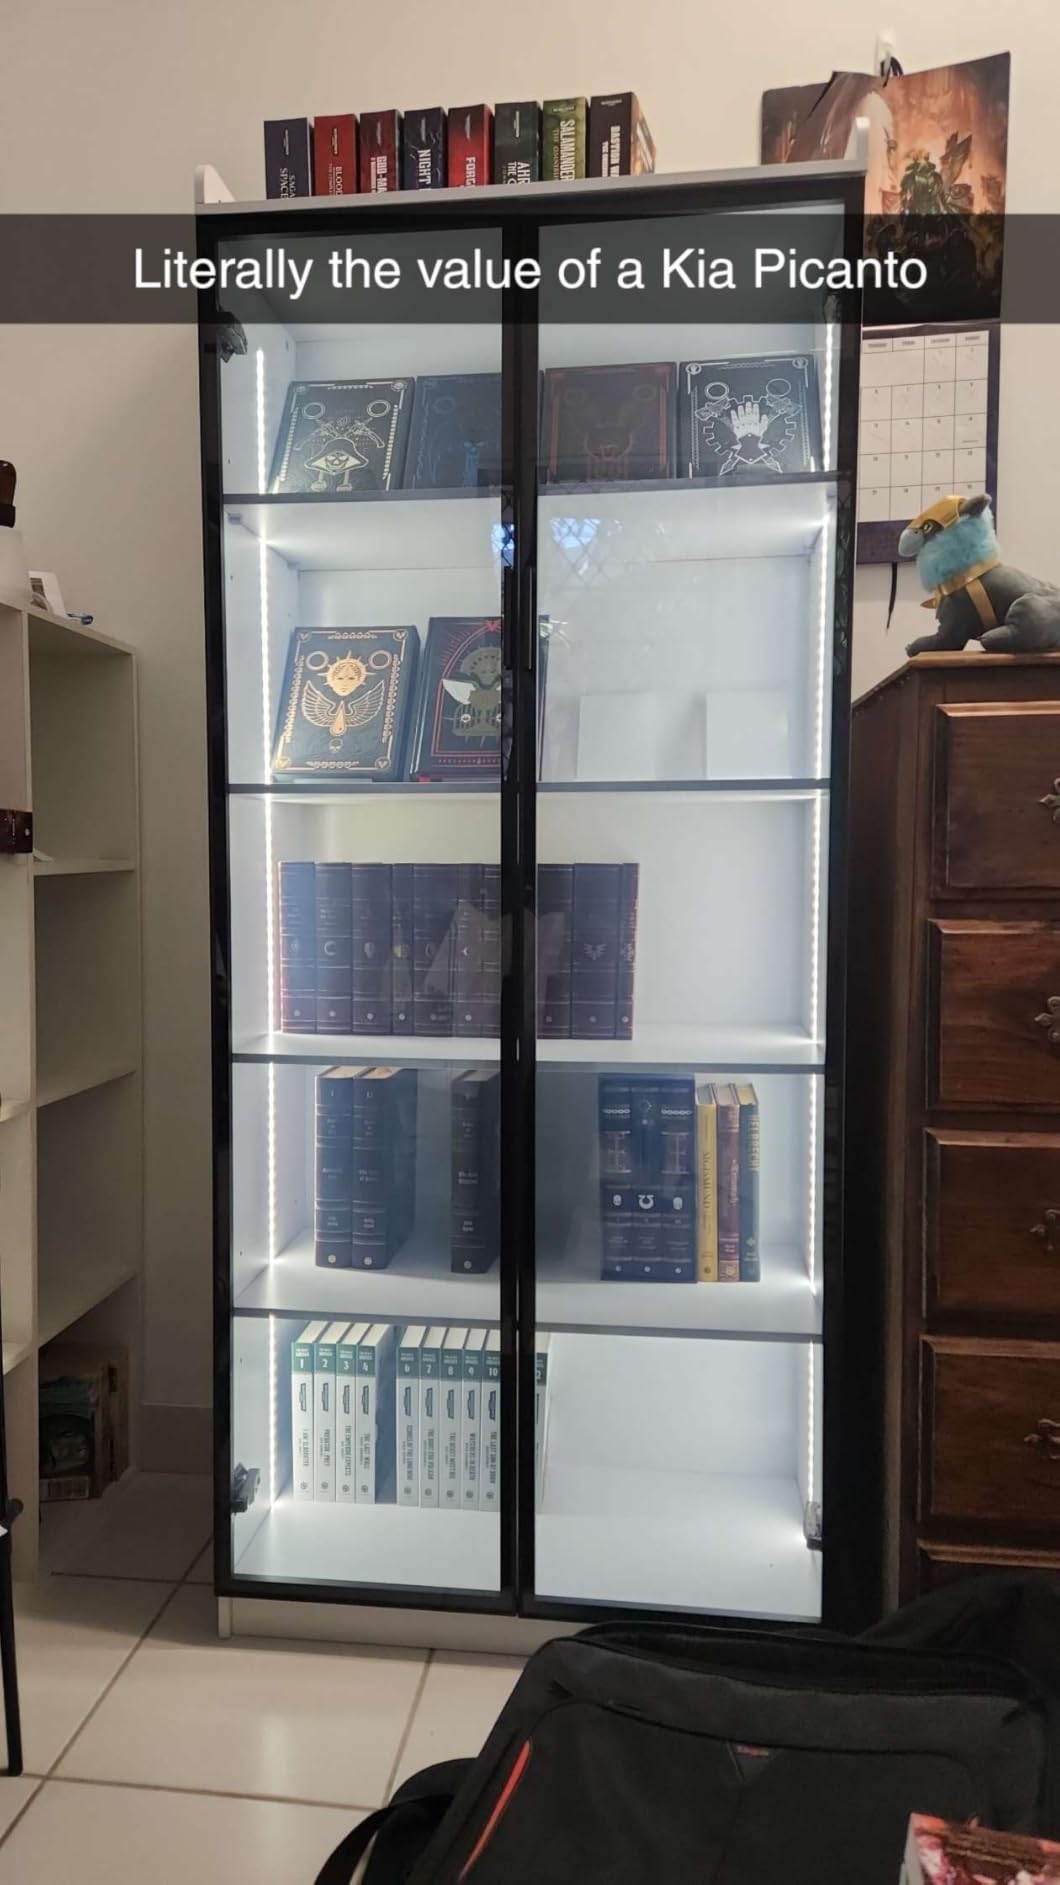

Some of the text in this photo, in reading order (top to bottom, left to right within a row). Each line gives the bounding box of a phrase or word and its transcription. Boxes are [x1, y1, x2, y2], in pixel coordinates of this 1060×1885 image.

[418, 149, 431, 184] NIGHT
[508, 161, 516, 176] THE
[466, 157, 476, 187] FORG
[300, 1359, 304, 1368] 1
[322, 1359, 328, 1368] 2
[344, 1361, 349, 1370] 3
[362, 1362, 368, 1371] 4
[426, 1365, 432, 1374] 7
[468, 1366, 474, 1376] 9
[489, 1367, 498, 1377] 10
